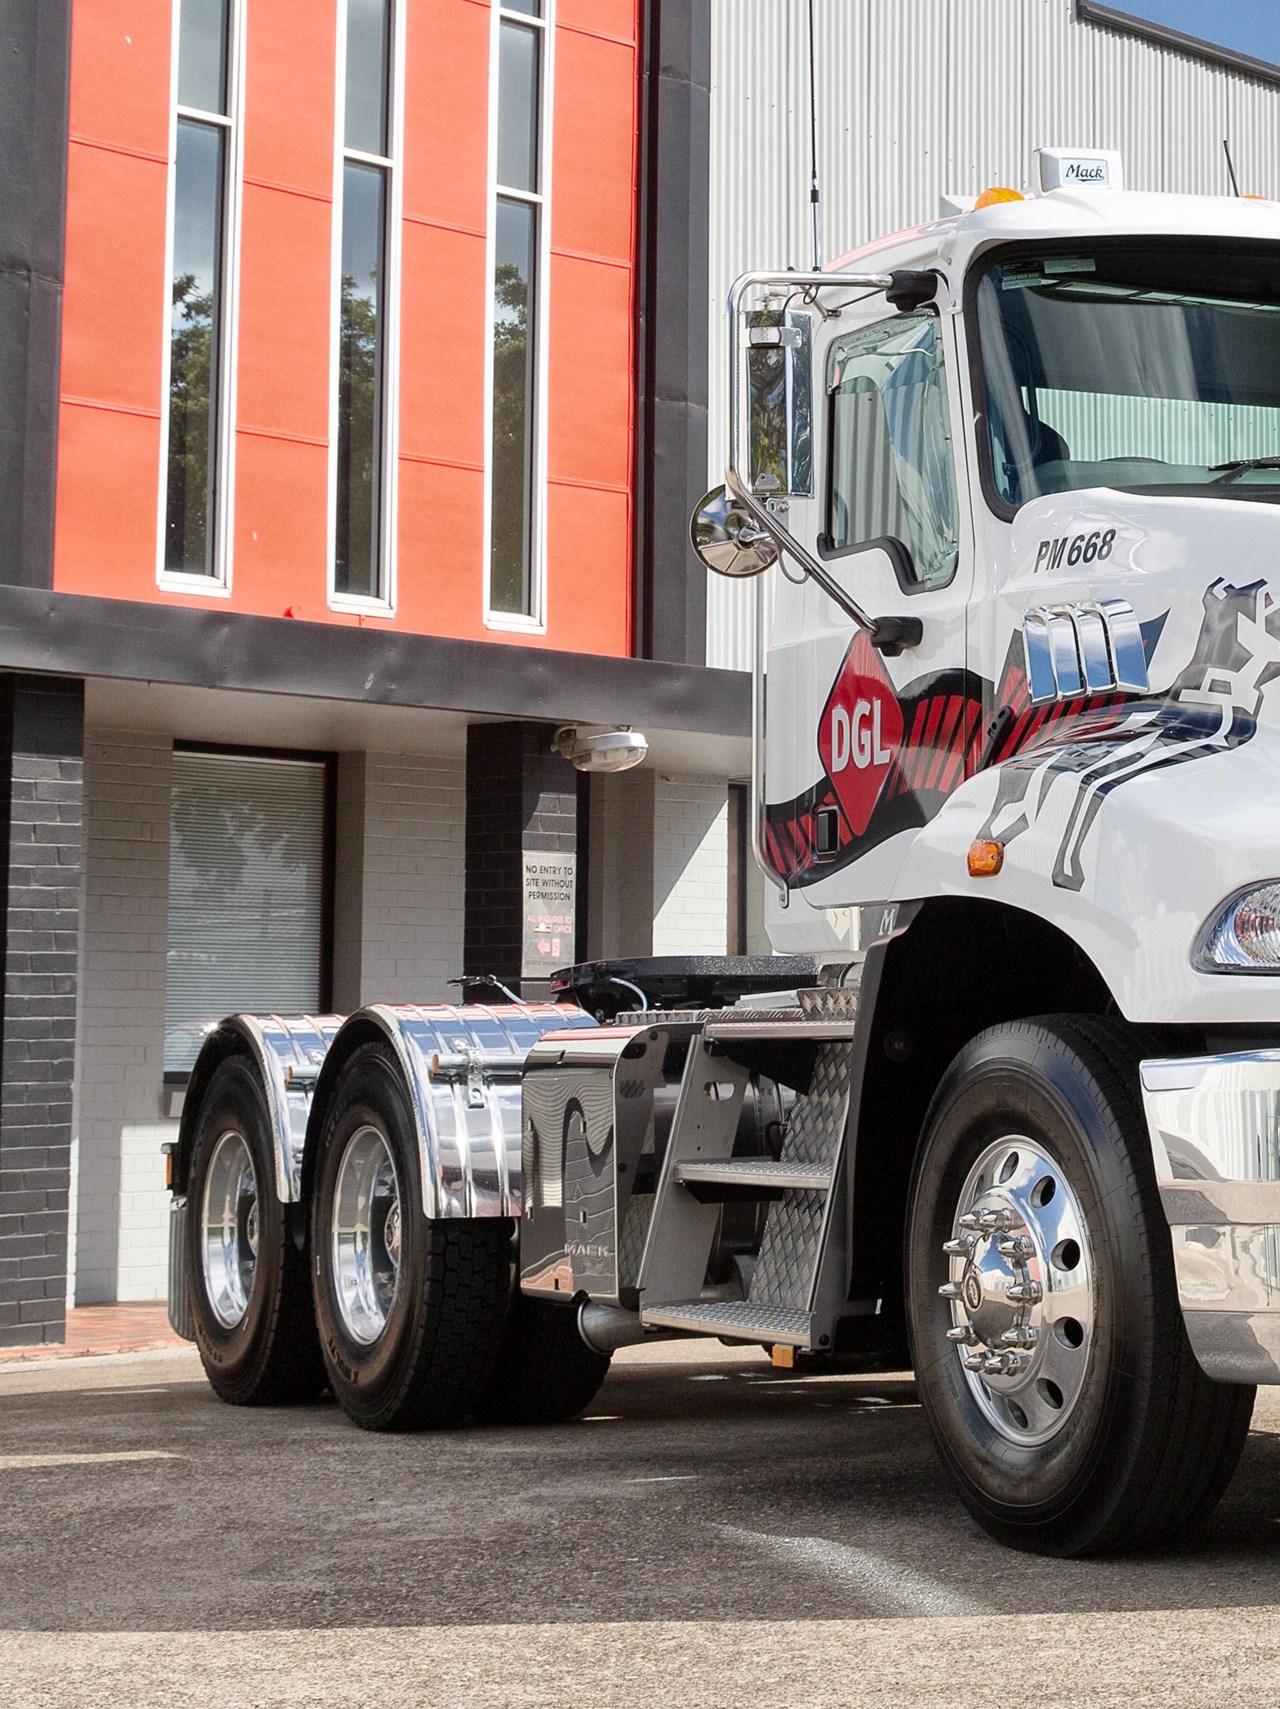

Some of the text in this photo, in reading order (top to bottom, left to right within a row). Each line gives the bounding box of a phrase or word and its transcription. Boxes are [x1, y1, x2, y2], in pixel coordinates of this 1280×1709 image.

[1065, 164, 1105, 182] Mack
[831, 698, 891, 773] DGL
[525, 865, 573, 876] NO ENTRY TO
[525, 878, 573, 889] SITE WITHOUT
[528, 891, 571, 901] PERMISSION
